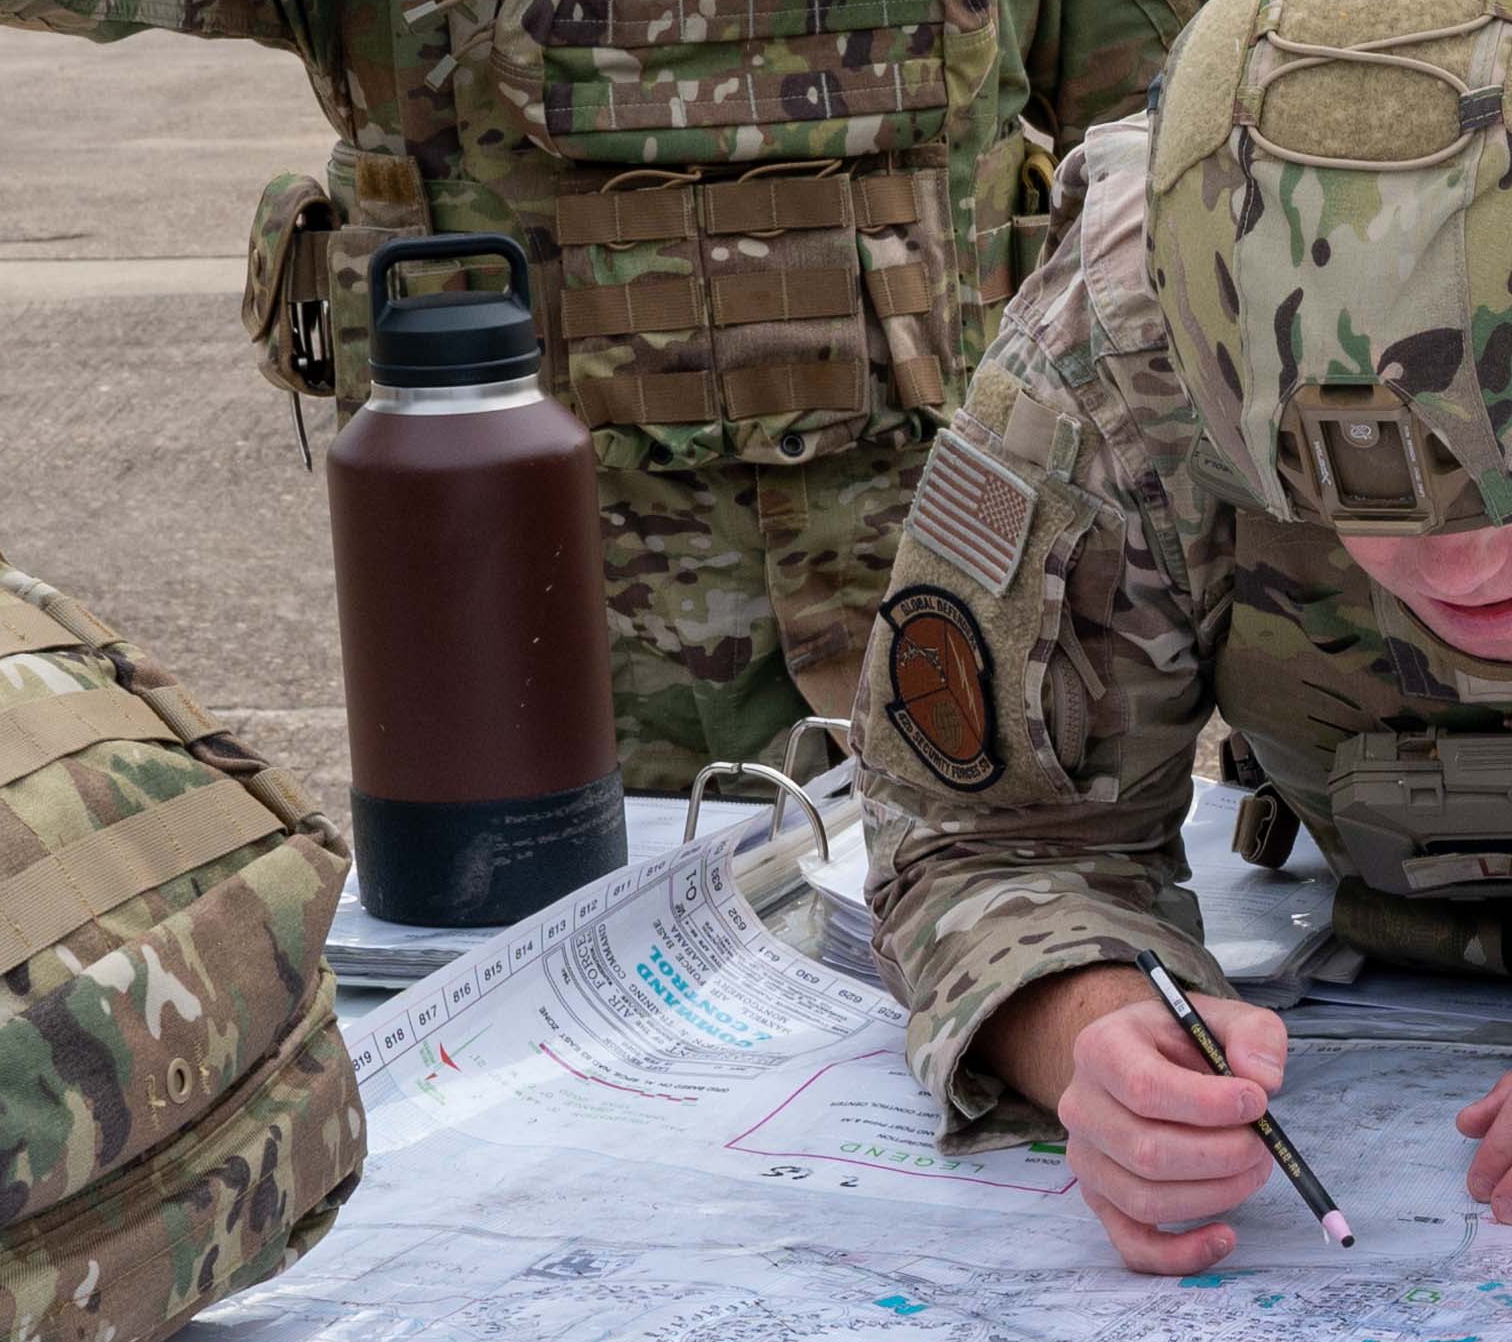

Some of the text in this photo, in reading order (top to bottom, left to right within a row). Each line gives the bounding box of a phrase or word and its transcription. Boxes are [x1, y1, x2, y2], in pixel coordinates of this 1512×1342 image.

[901, 596, 936, 616] GLOBAL
[912, 732, 951, 776] SECURITY
[950, 762, 981, 778] FORCES
[597, 924, 627, 980] COMMAND
[653, 920, 676, 949] BASE
[669, 925, 709, 973] ALABAMA
[384, 1027, 406, 1050] 818
[419, 1004, 438, 1027] 817
[453, 983, 472, 1004] 816
[484, 961, 503, 981] 815
[515, 940, 534, 960] 814
[548, 919, 567, 940] 813
[580, 899, 598, 918] 812
[614, 880, 632, 897] 811
[574, 936, 606, 989] FORCE
[676, 952, 706, 987] FORCE
[727, 907, 748, 932] 632
[796, 969, 820, 985] 630
[838, 989, 863, 1004] 629
[608, 995, 634, 1019] AIR
[628, 983, 675, 1026] TRAINING
[634, 961, 753, 1050] COMMAND
[646, 945, 749, 1034] CONTROL
[539, 1006, 560, 1032] ZONE
[831, 1100, 869, 1108] CENTER
[871, 1102, 920, 1115] CONTROL
[840, 1141, 984, 1175] LEGEND
[1025, 1157, 1061, 1166] COLOR
